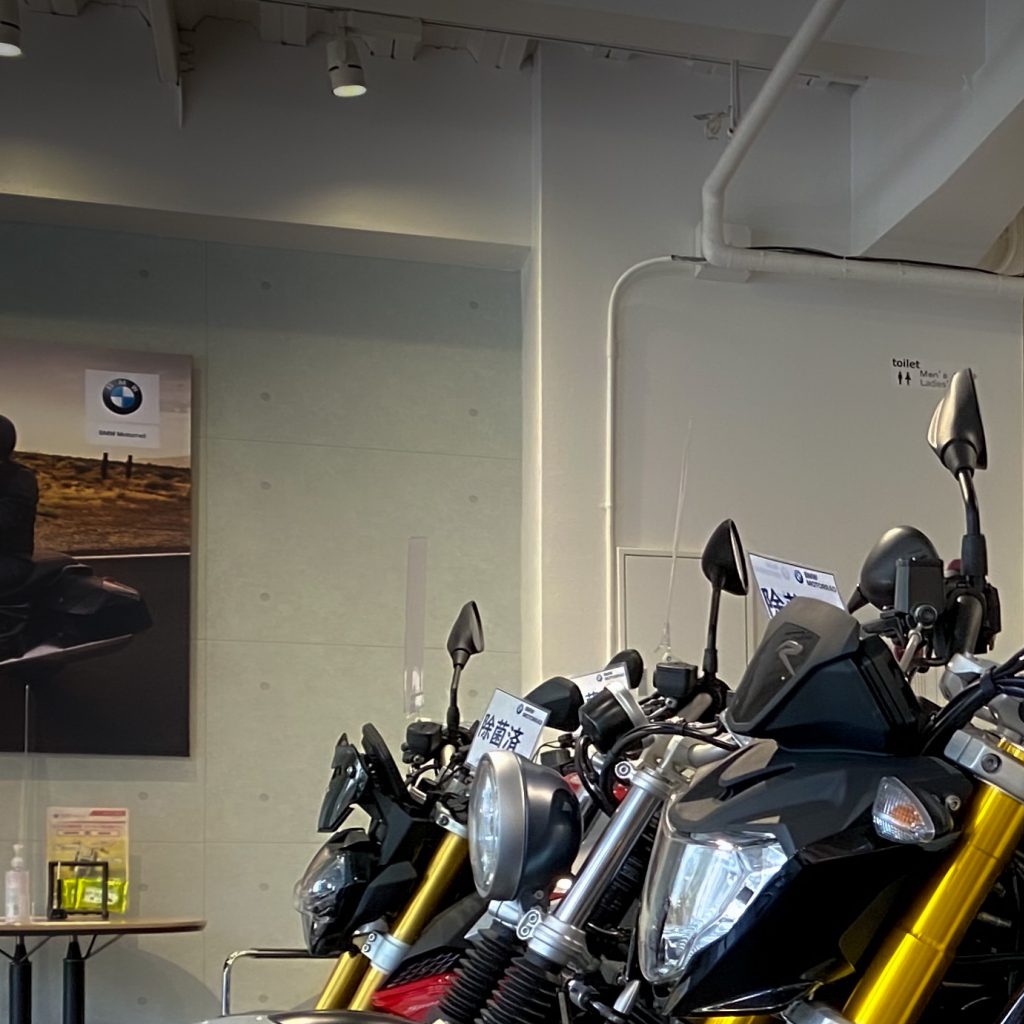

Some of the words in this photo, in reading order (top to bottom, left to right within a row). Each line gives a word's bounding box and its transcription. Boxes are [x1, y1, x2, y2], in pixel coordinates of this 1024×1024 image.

[892, 358, 920, 369] toilet
[478, 713, 525, 751] 除菌済
